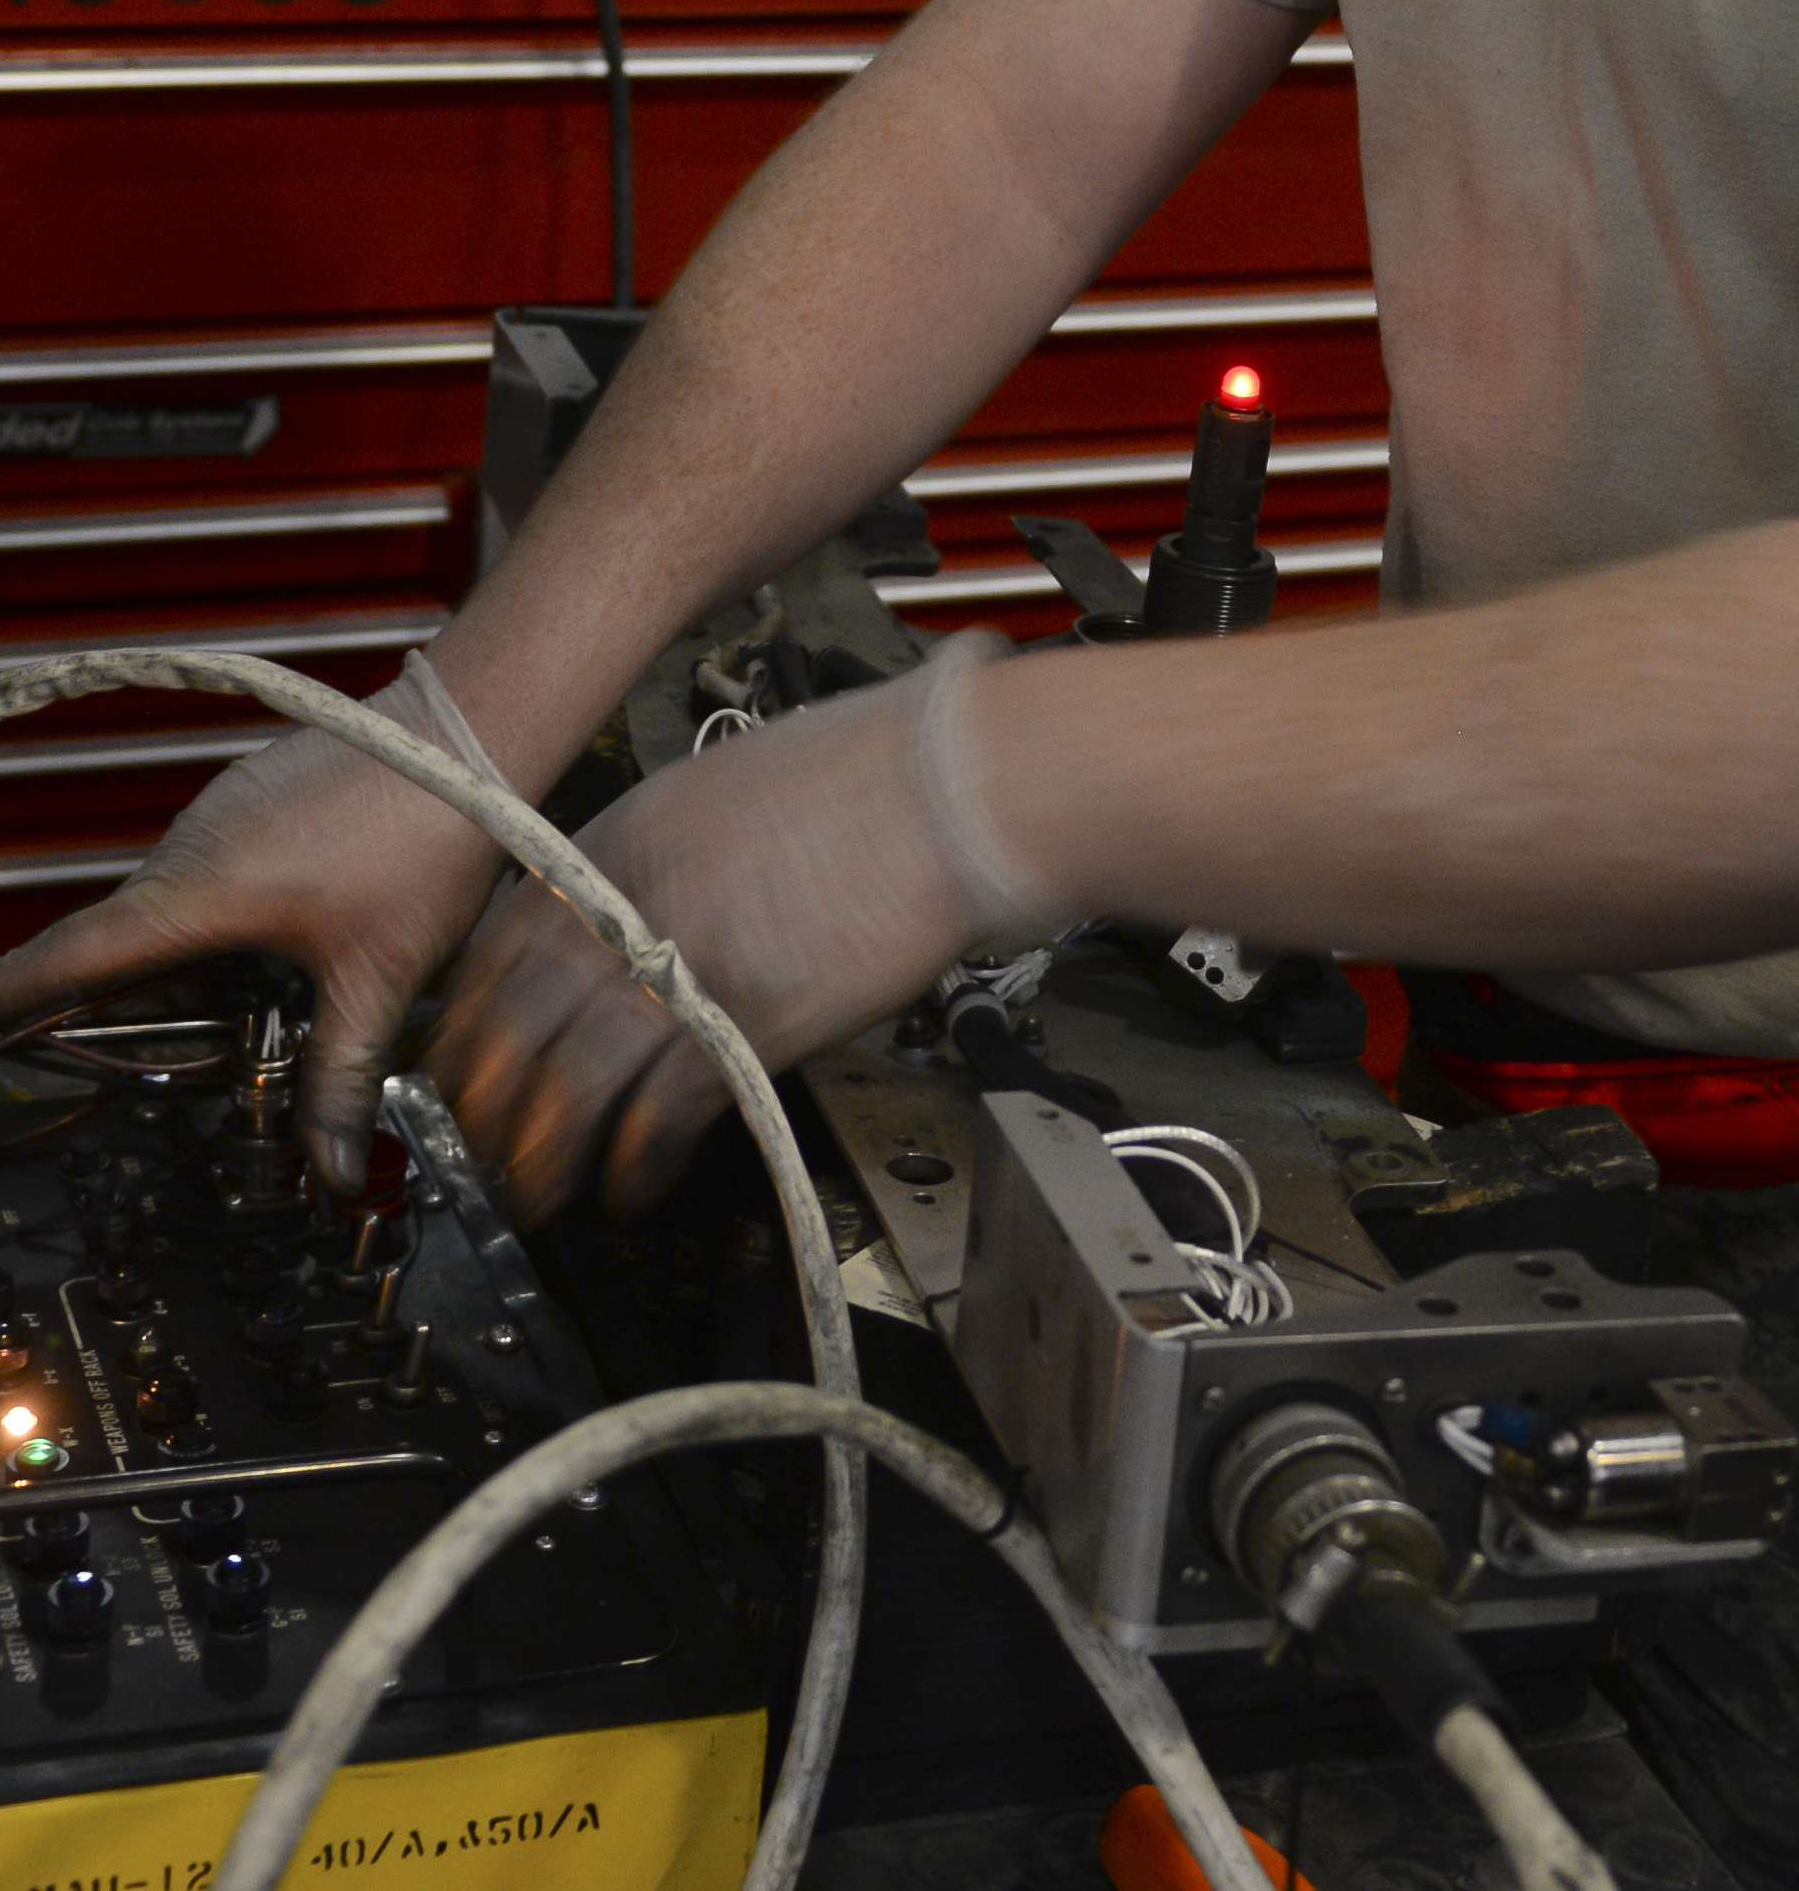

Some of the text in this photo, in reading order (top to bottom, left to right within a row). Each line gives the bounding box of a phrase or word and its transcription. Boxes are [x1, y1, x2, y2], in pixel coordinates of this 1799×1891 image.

[78, 1349, 130, 1454] WEAPONS OFF RACK
[0, 1604, 22, 1630] SOL
[140, 1535, 201, 1662] SAFETY SOL UNLOCK
[5, 1634, 37, 1682] SAFETY
